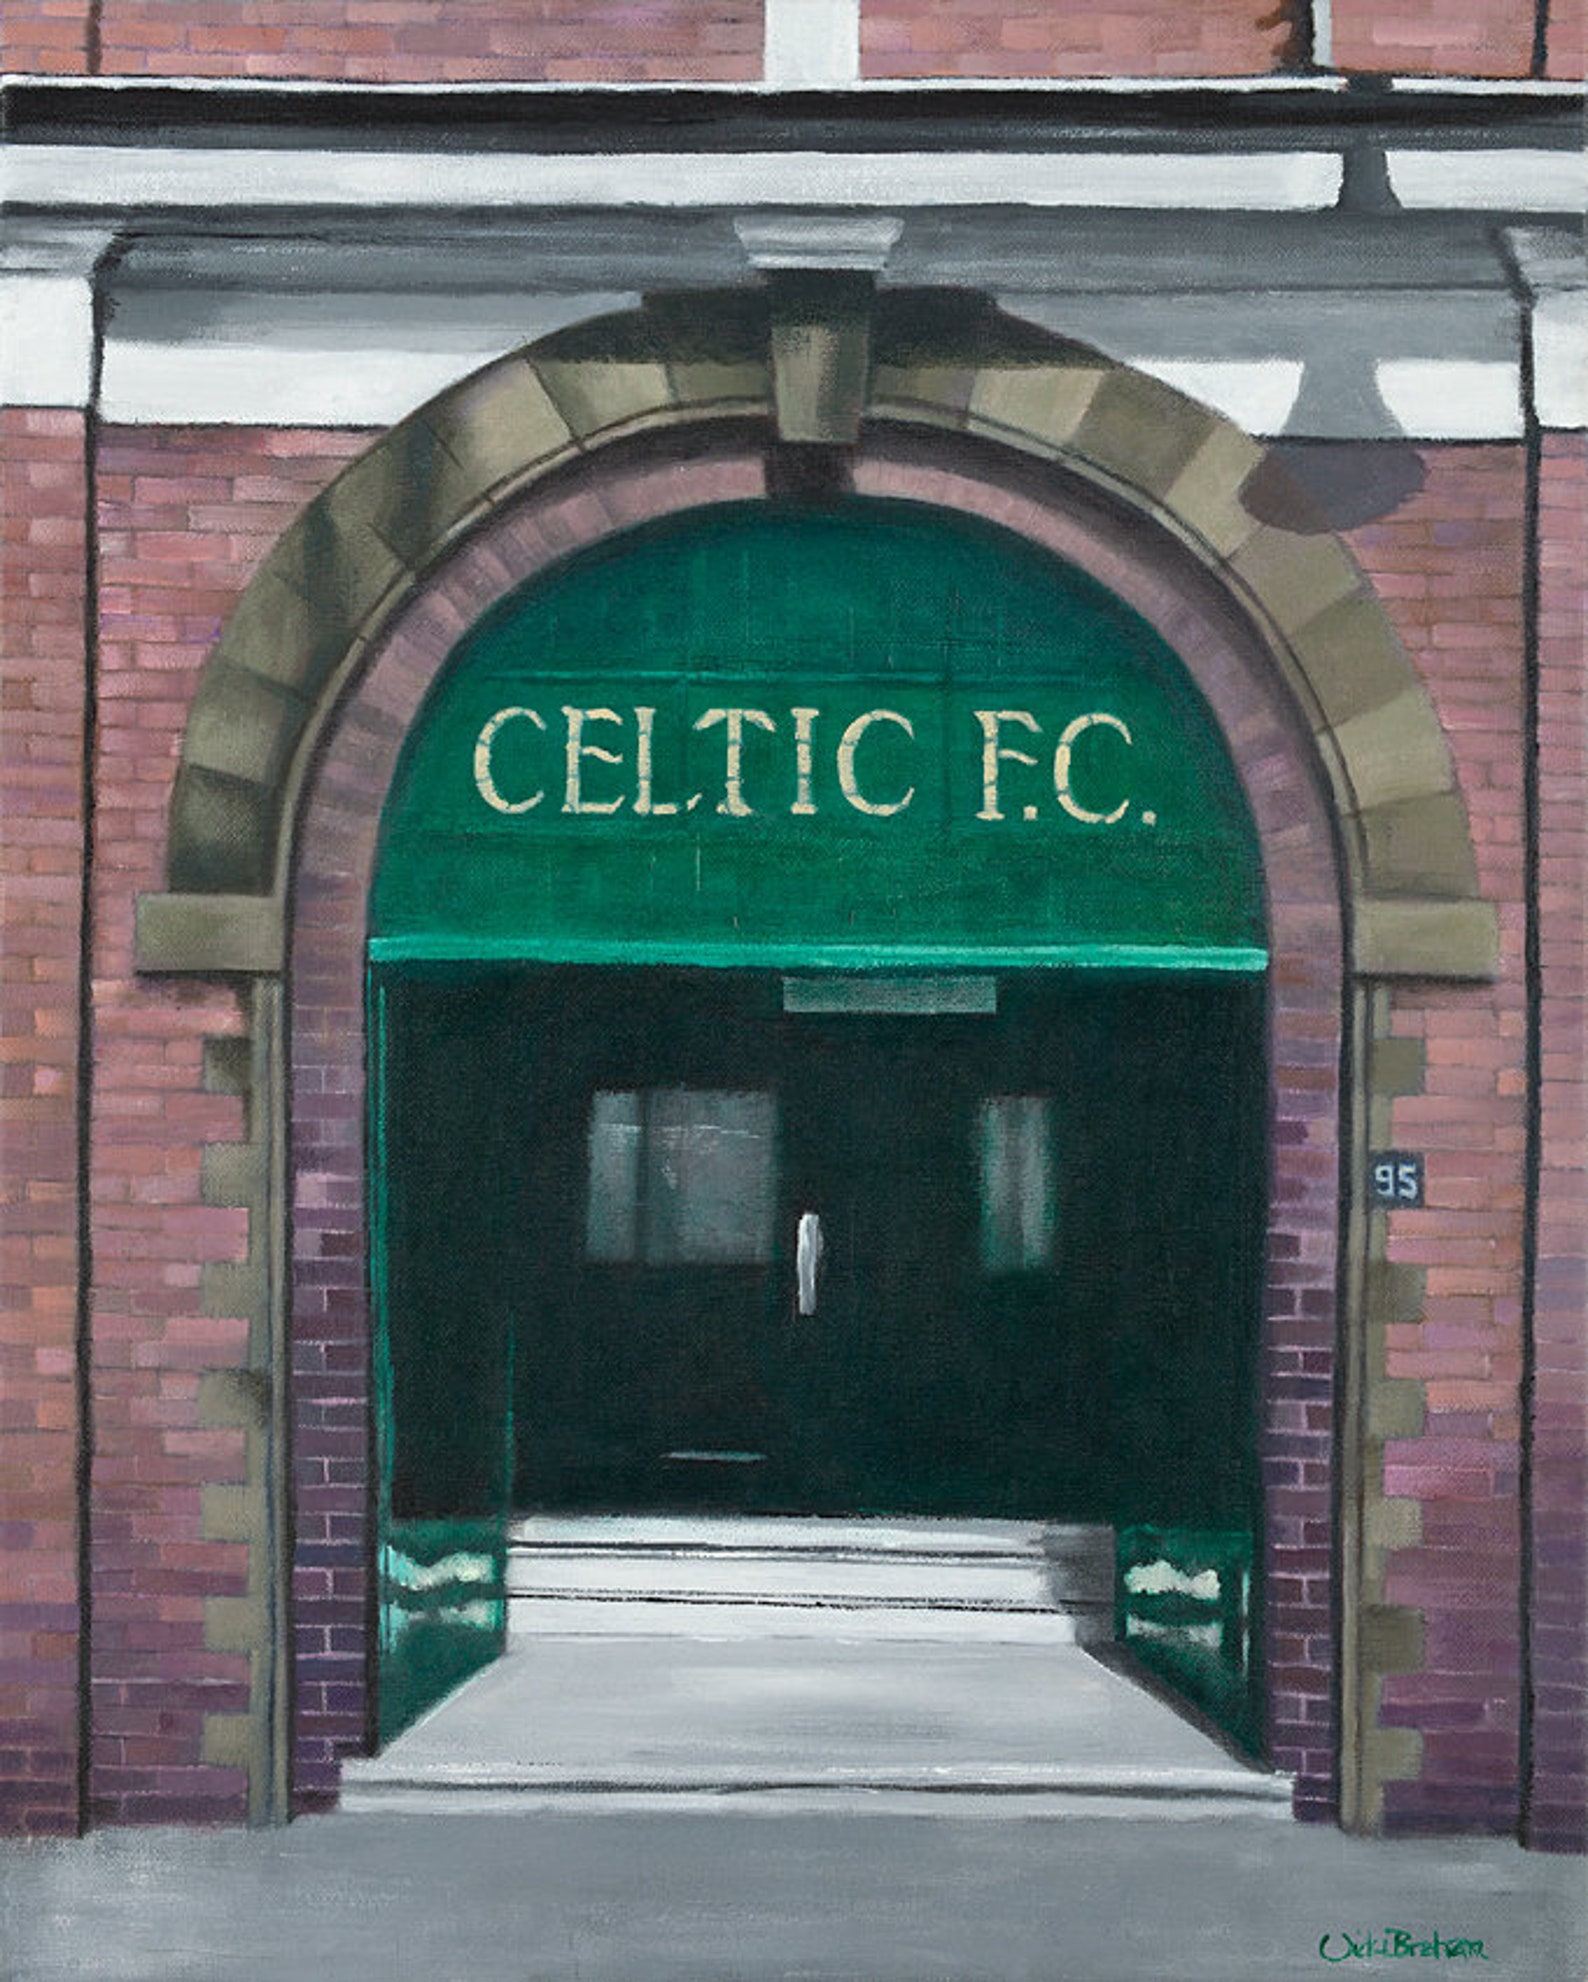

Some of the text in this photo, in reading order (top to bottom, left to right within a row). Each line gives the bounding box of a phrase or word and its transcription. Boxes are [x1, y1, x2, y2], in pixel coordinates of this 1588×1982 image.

[474, 706, 1157, 824] CELTIC F.C.
[1375, 1163, 1418, 1200] 95
